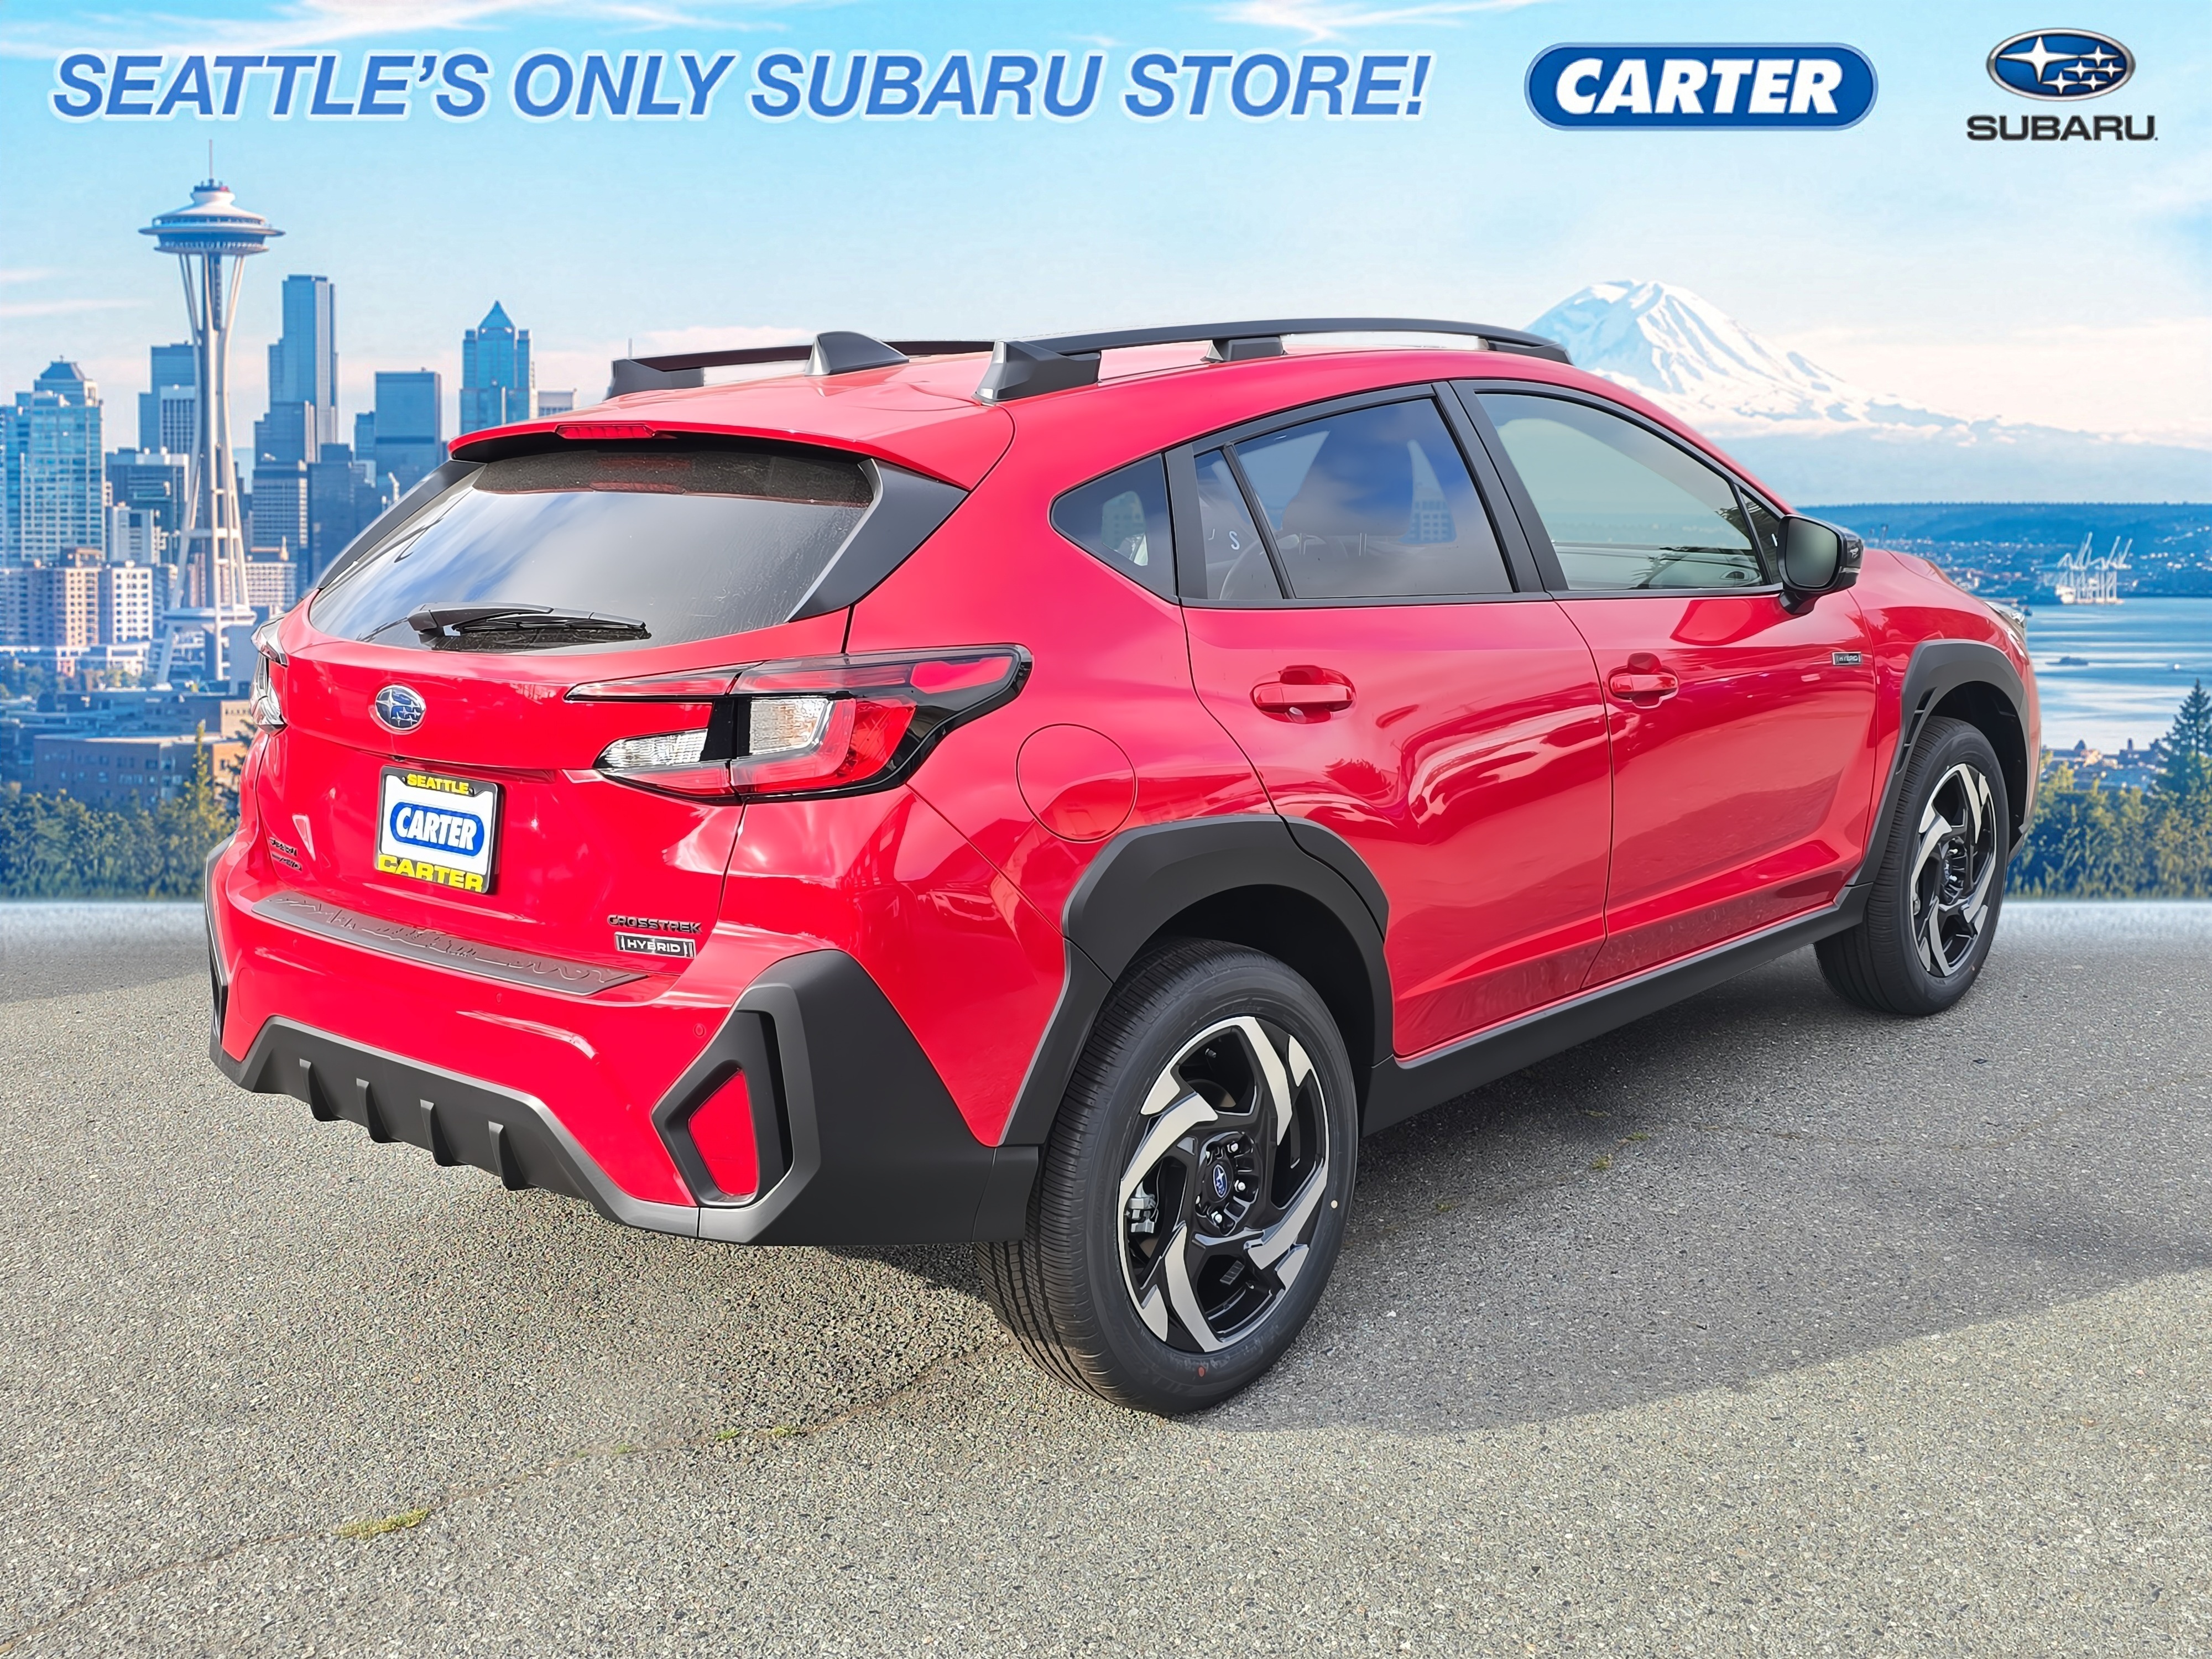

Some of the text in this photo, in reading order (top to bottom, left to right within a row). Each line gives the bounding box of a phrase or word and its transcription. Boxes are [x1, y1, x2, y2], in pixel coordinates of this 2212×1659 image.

[407, 774, 469, 795] SEATTLE
[396, 806, 477, 851] CARTER
[378, 854, 484, 893] CARTER
[607, 915, 703, 934] CROSSTREK
[627, 939, 681, 953] HYBRID
